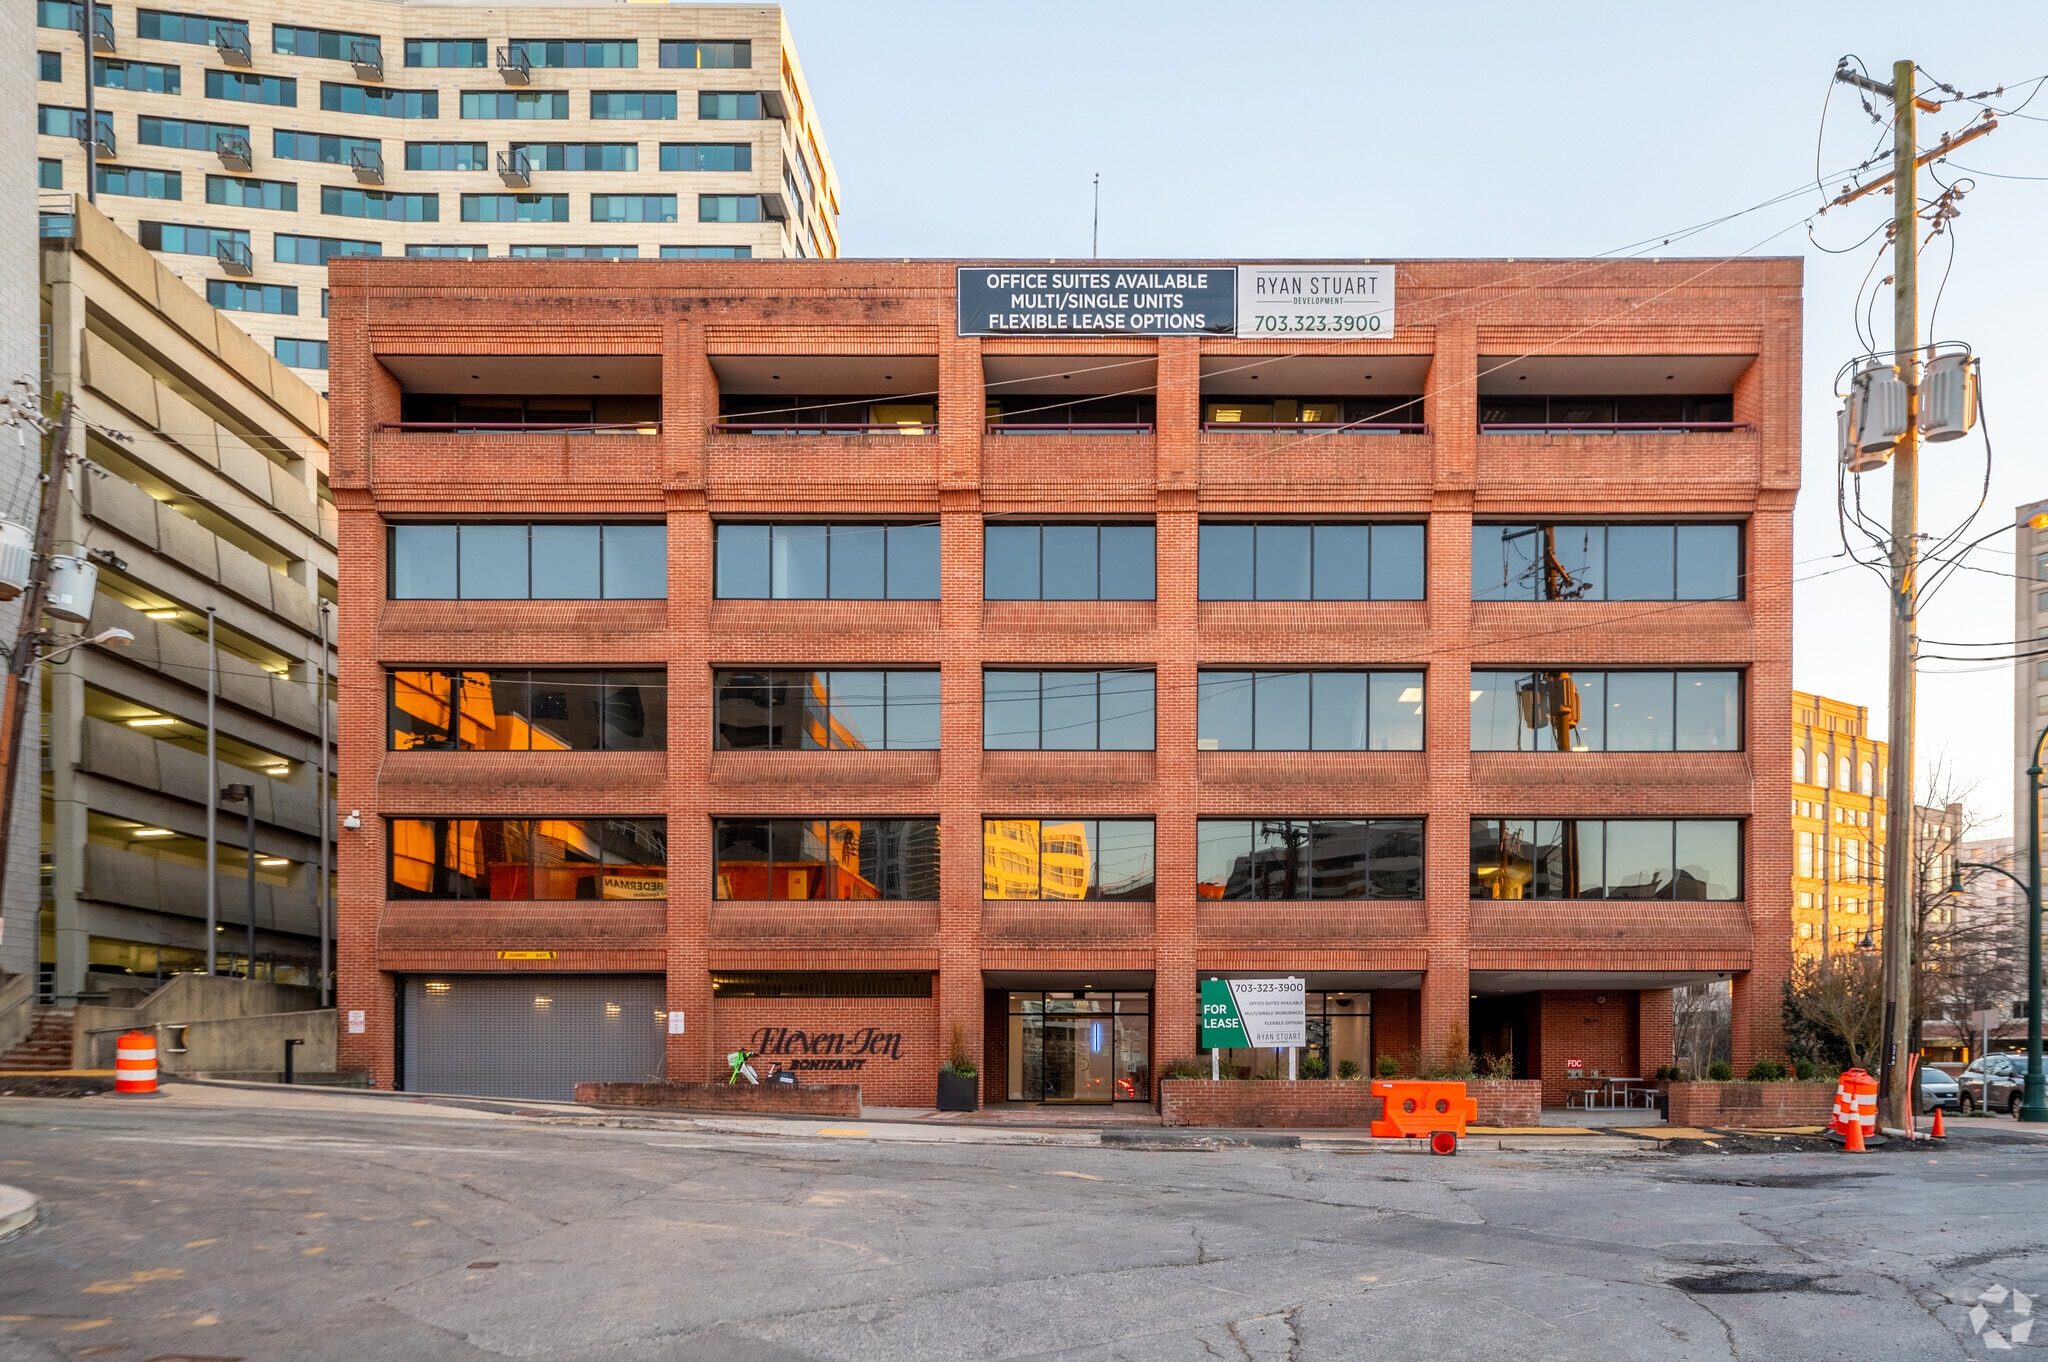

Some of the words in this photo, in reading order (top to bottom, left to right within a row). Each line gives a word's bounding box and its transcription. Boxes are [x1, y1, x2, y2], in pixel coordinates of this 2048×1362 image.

[986, 273, 1048, 289] OFFICE
[1052, 273, 1111, 289] SUITES
[1114, 273, 1208, 289] AVAILABLE
[1256, 276, 1301, 295] RYAN
[1310, 276, 1378, 295] STUART
[1011, 292, 1129, 310] MULTI/SINGLE
[1133, 293, 1184, 309] UNITS
[1293, 297, 1343, 305] DEVELOPMENT
[989, 313, 1068, 329] FLEXIBLE
[1072, 313, 1126, 329] LEASE
[1130, 313, 1206, 329] OPTIONS
[1254, 315, 1381, 332] 703.323.3900
[1235, 983, 1303, 993] 703-323-3900
[1203, 1004, 1227, 1014] FOR
[1203, 1018, 1239, 1029] LEASE
[1256, 1033, 1274, 1041] RYAN
[1276, 1032, 1301, 1041] STUART
[788, 1059, 867, 1070] BONIFANT
[1567, 1059, 1582, 1068] FDC
